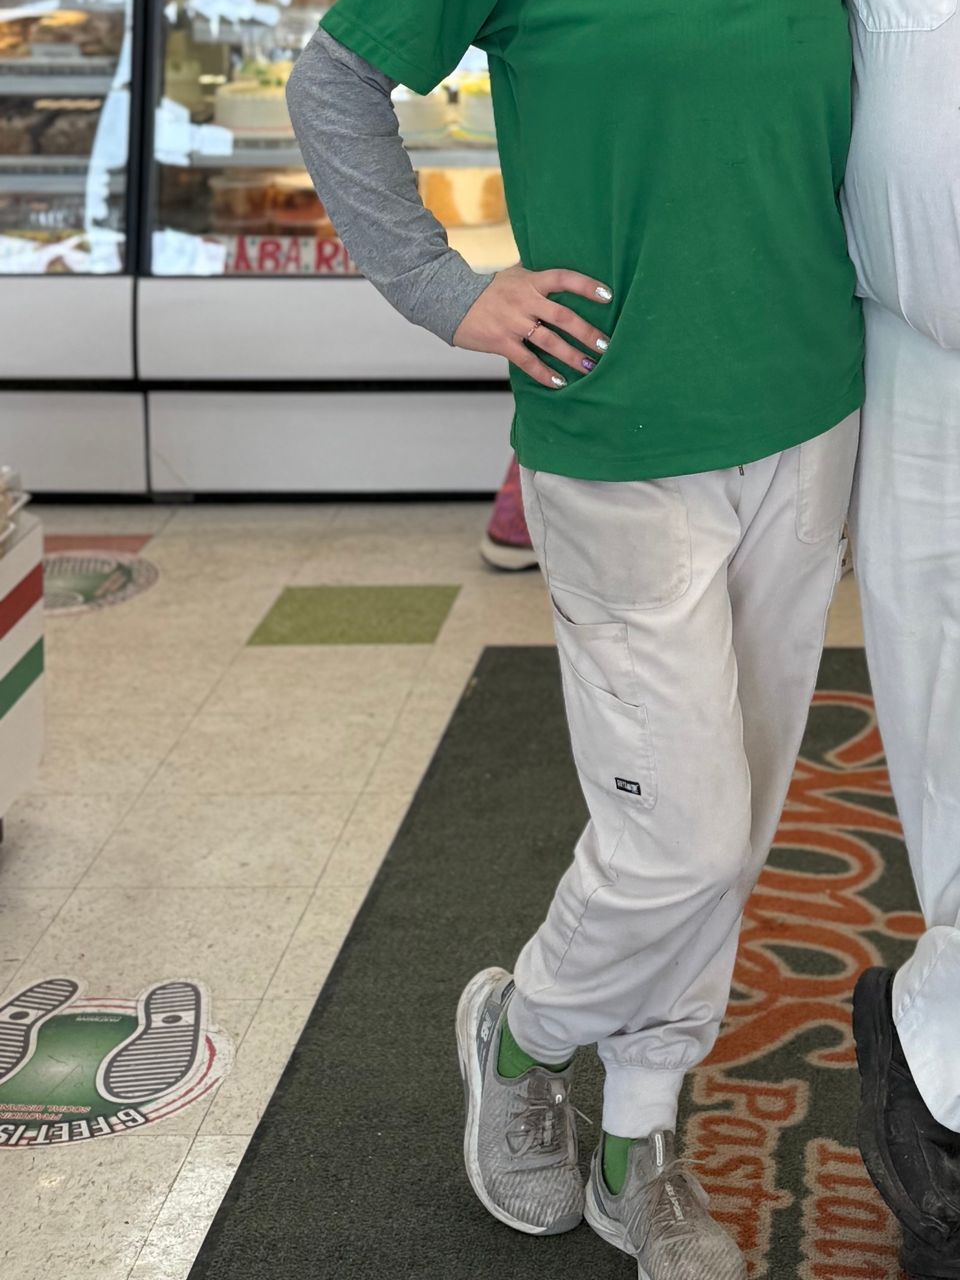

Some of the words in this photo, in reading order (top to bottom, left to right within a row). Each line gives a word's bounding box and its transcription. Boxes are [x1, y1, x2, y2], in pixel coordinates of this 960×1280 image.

[690, 690, 927, 1070] Moios
[30, 1116, 114, 1145] FEET
[116, 1107, 148, 1128] 6
[687, 1076, 799, 1278] Pastr
